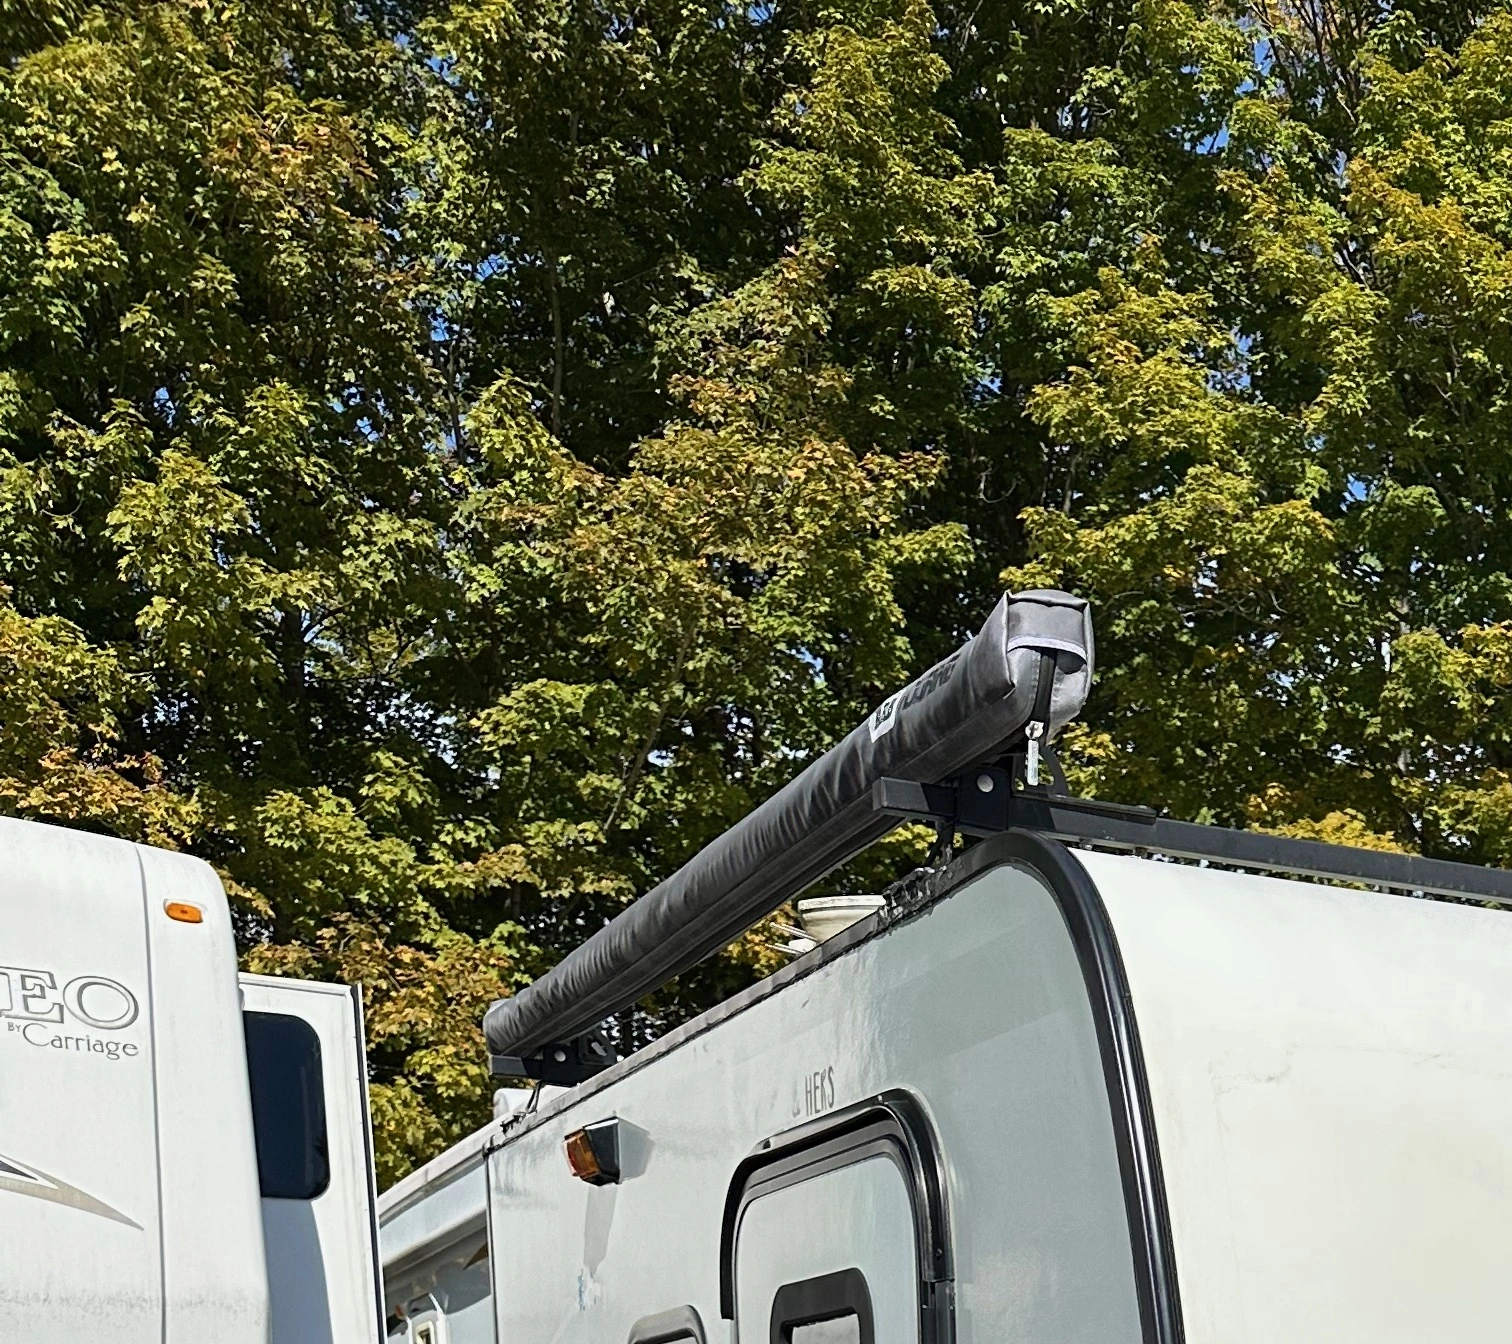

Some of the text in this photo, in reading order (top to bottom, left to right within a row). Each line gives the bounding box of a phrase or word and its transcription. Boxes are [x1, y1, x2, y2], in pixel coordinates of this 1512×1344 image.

[7, 1022, 139, 1060] BY Carriage
[805, 1066, 835, 1117] HERS
